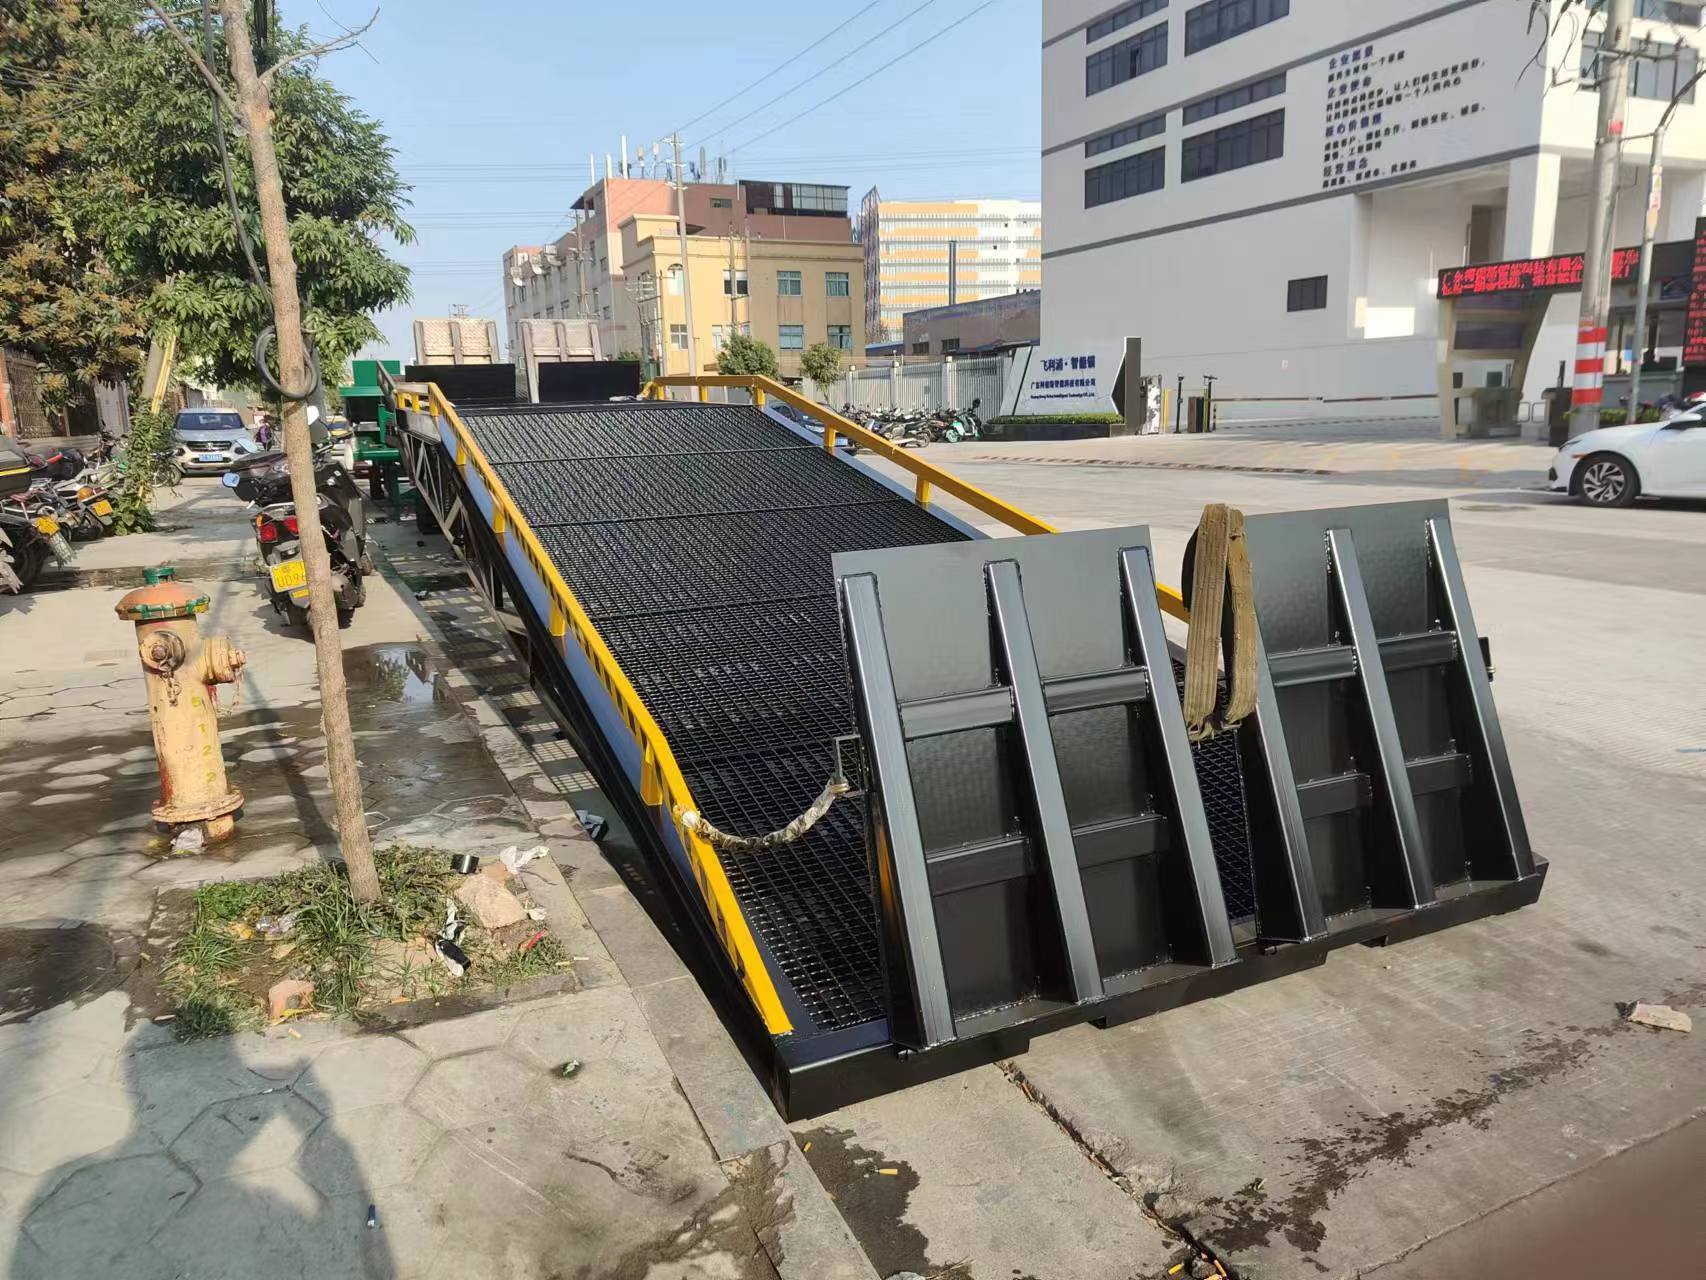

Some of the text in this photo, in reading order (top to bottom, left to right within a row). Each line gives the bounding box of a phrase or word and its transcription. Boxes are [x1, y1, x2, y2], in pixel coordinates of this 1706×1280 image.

[1325, 112, 1382, 138] 核心价值观
[1323, 157, 1368, 177] 经营理念
